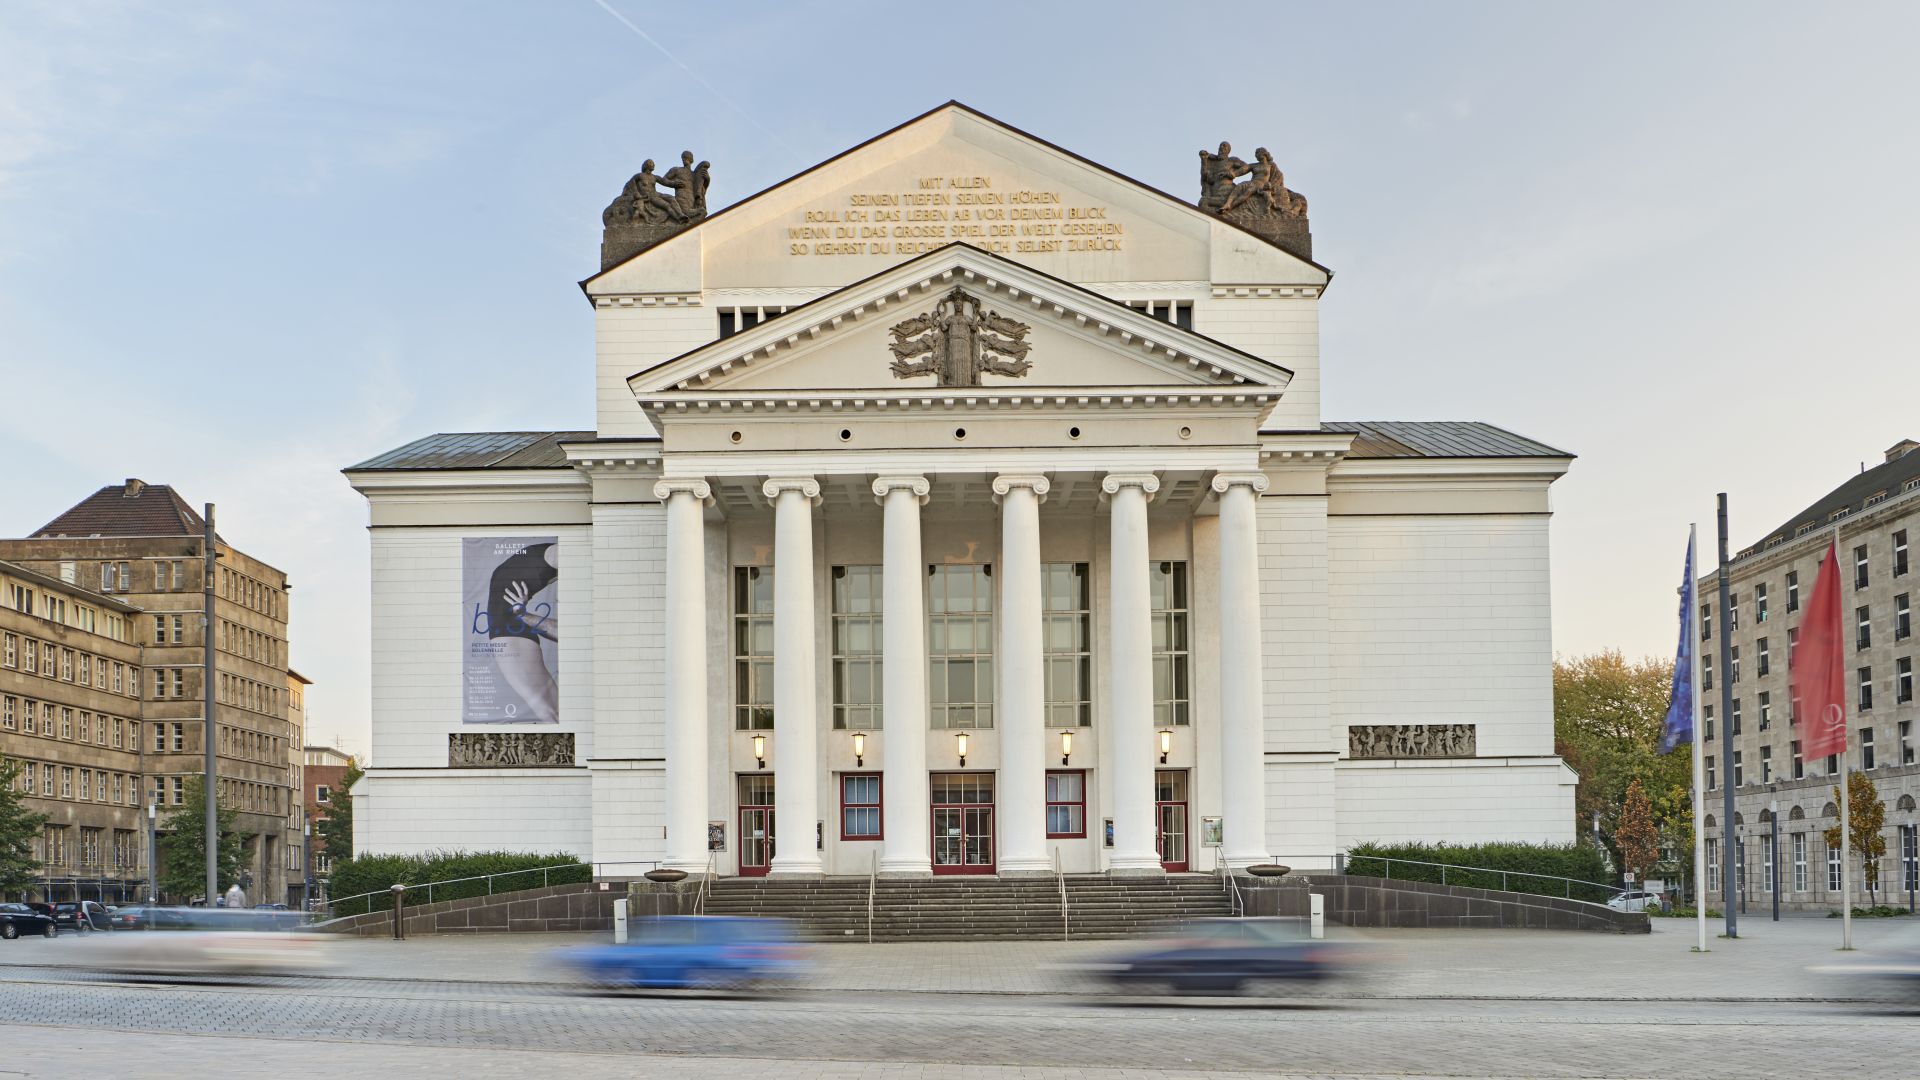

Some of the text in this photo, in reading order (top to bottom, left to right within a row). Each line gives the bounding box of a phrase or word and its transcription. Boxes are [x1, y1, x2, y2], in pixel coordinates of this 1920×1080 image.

[919, 176, 992, 190] MIT ALLEN
[850, 190, 1060, 207] SEINEN TIEFEN SEINEN HÖHEN
[805, 207, 1107, 223] ROLL ICH DAS LEBEN AB VOR DEINEM BLICK
[788, 223, 1124, 240] WENN DU DAS GROSSE SPIEL DER WELT GESEHEN
[790, 243, 809, 256] SO
[815, 243, 866, 256] KEHRST
[870, 243, 891, 255] DU
[1016, 240, 1062, 253] SELBST
[1068, 236, 1122, 252] ZURÜCK
